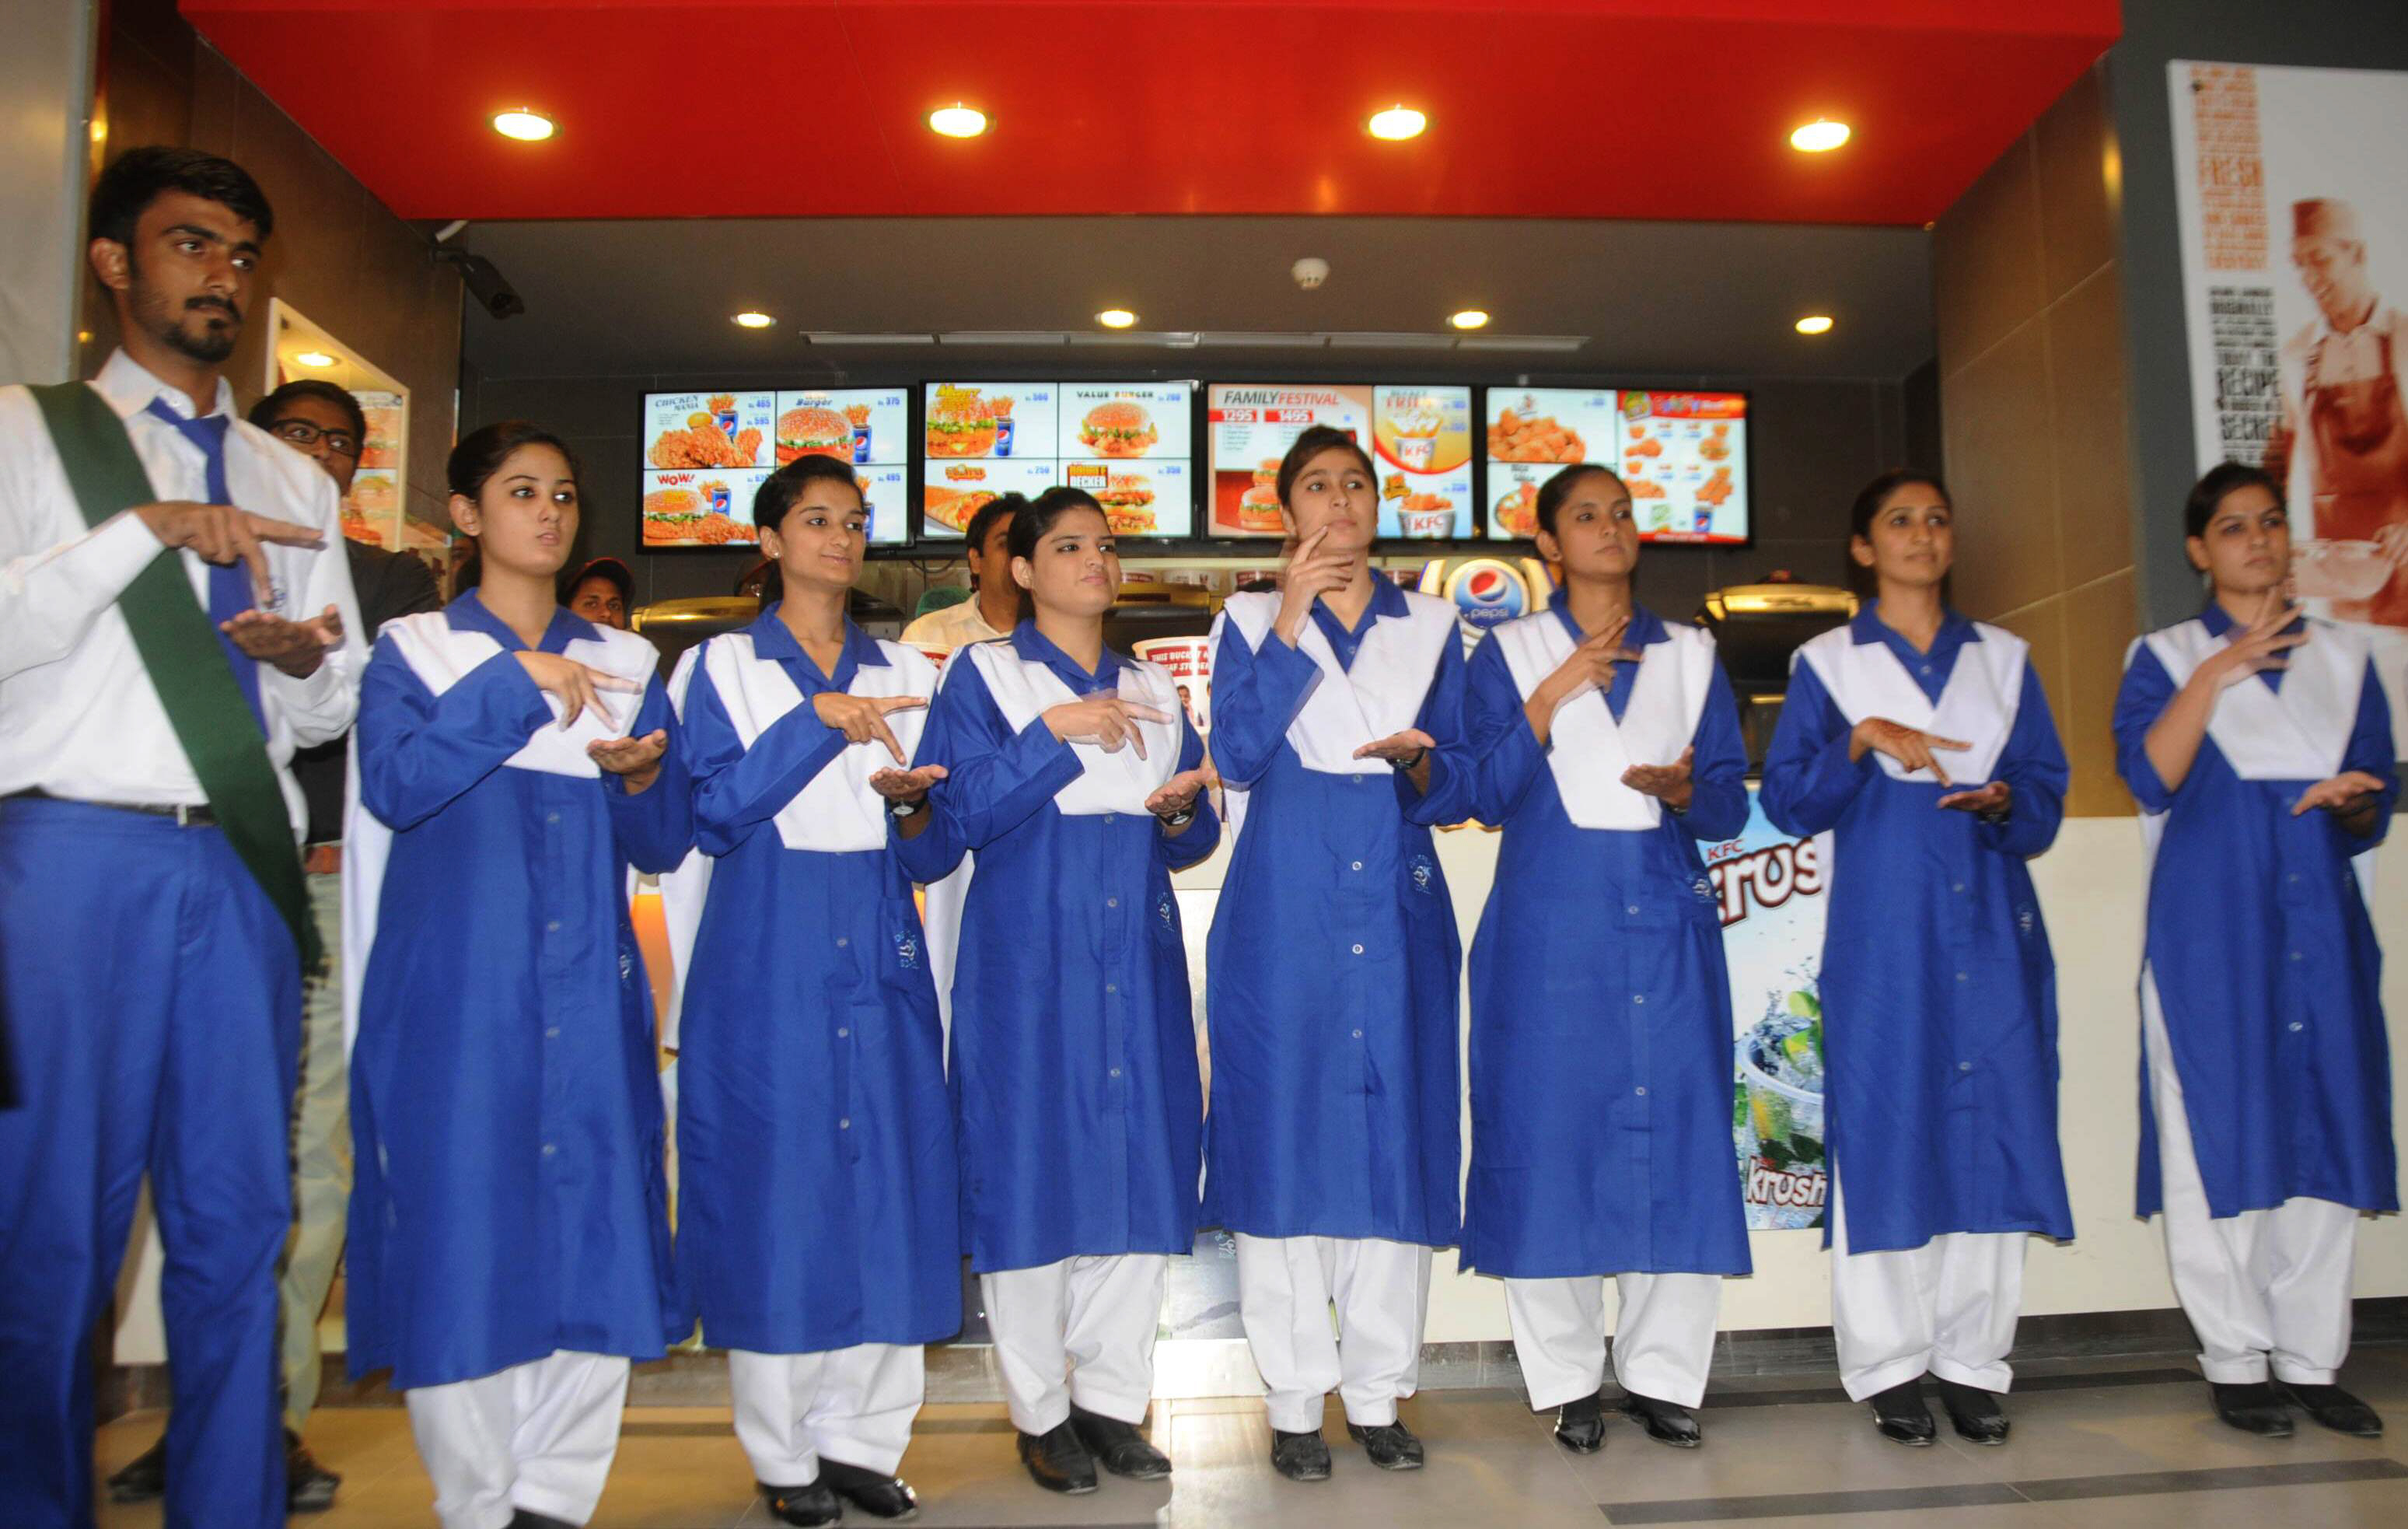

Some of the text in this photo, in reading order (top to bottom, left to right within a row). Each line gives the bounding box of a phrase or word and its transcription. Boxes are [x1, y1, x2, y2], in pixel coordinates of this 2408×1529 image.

[655, 395, 699, 408] CHICKEN
[1224, 390, 1340, 406] FAMILY FESTIVAL
[1223, 410, 1253, 422] 1295
[1405, 444, 1430, 457] KFC
[1414, 516, 1444, 530] KFC
[1470, 609, 1508, 620] pepsi
[1707, 839, 1742, 861] KFC
